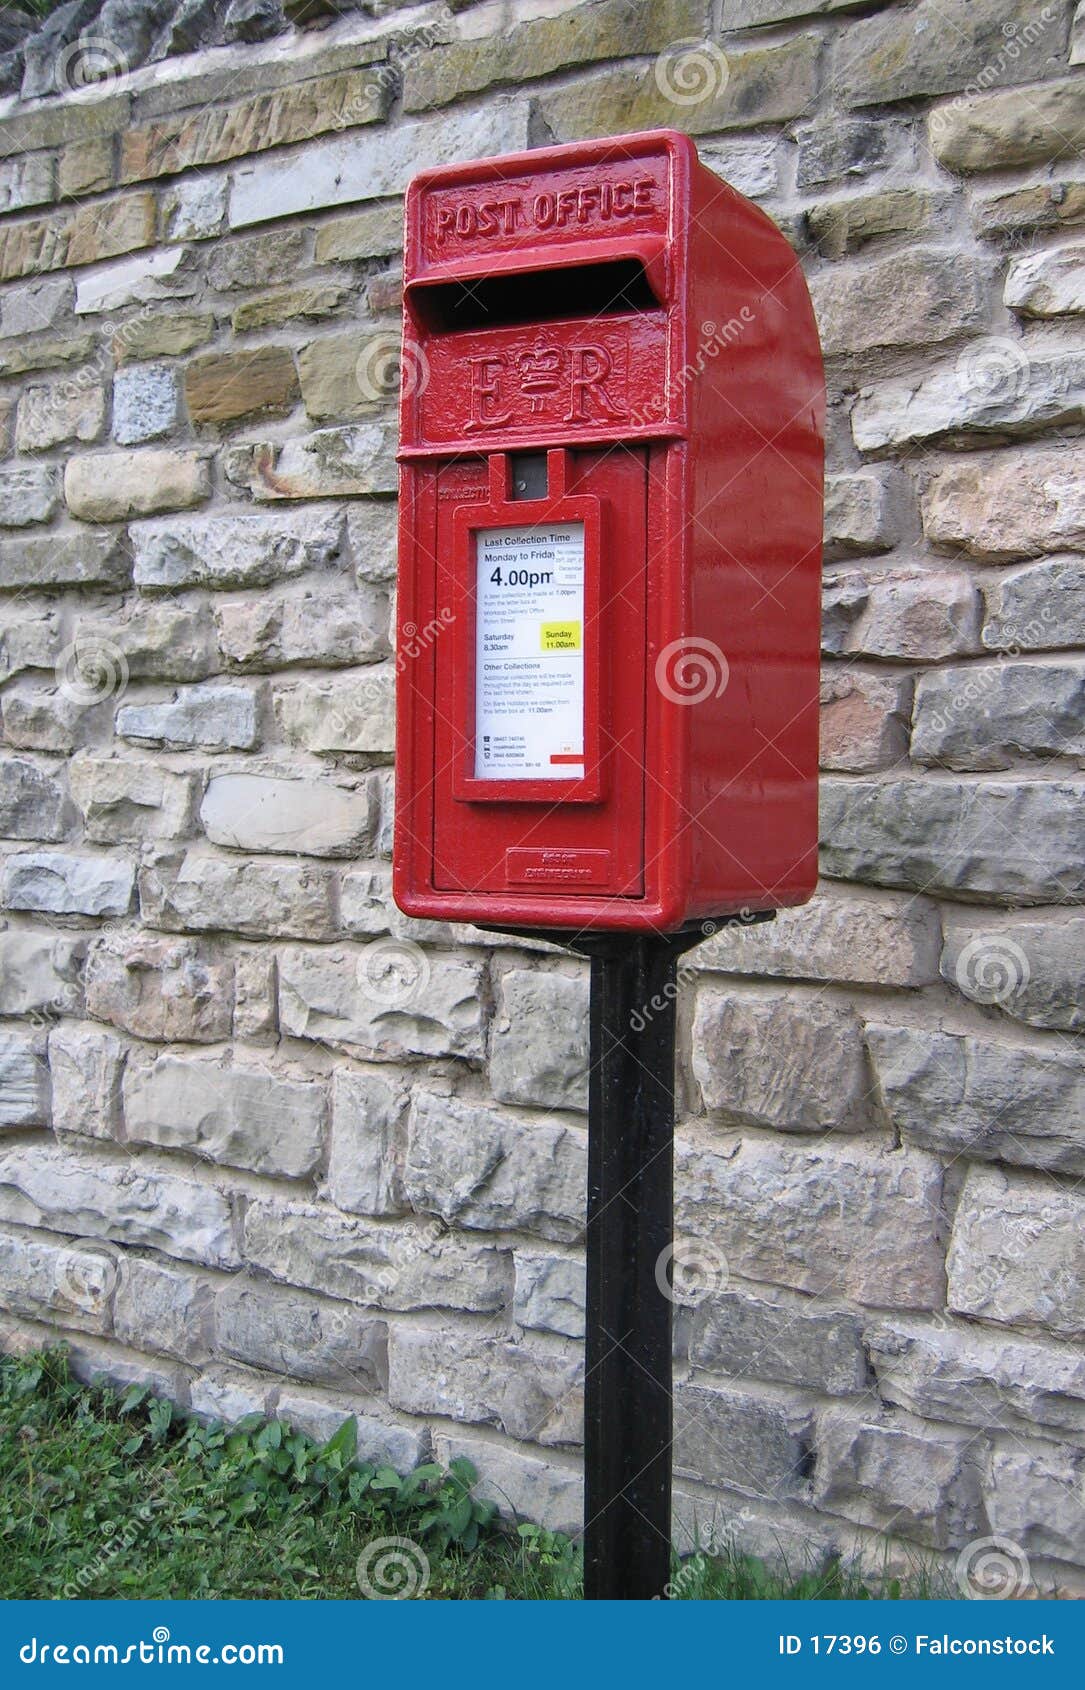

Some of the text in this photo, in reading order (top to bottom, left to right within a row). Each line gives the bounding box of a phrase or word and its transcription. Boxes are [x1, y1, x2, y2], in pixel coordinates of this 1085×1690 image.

[436, 177, 655, 244] POST OFFICE
[456, 343, 629, 431] E R
[484, 533, 571, 547] Last Collection Time
[484, 552, 518, 563] Monday
[520, 552, 529, 561] to
[490, 566, 554, 588] 4.00pm
[484, 633, 514, 641] Saturday
[546, 630, 572, 639] Sunday
[484, 644, 508, 652] 8.30am
[546, 641, 575, 649] 11.00am
[483, 662, 540, 671] Other Collections
